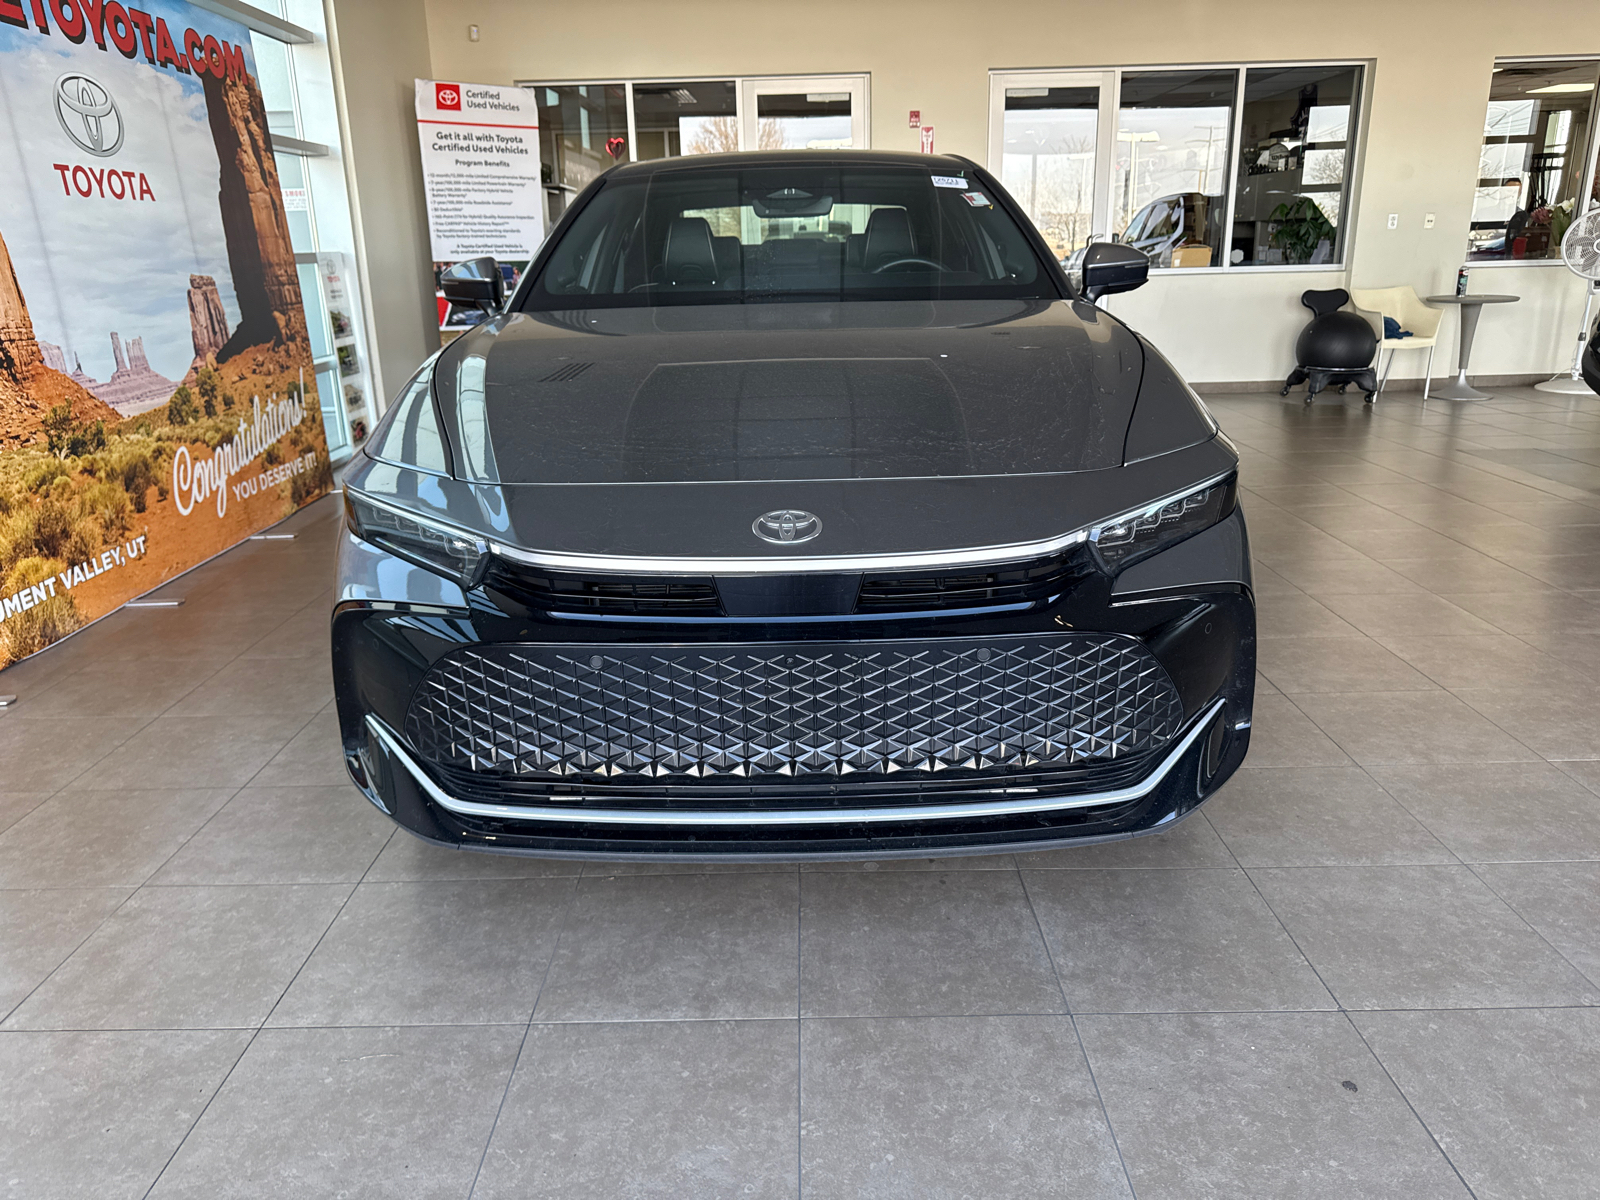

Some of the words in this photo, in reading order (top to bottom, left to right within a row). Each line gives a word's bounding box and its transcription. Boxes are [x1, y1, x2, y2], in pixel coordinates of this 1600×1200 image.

[466, 90, 500, 100] Certified
[467, 101, 487, 109] Used
[489, 102, 520, 112] Vehicles
[436, 131, 452, 141] Get
[454, 132, 461, 141] it
[463, 132, 474, 142] all
[475, 133, 495, 143] with
[495, 134, 523, 145] Toyota
[432, 143, 471, 152] Certified
[472, 144, 494, 153] Used
[494, 145, 529, 155] Vehicles
[455, 159, 483, 167] Program
[484, 159, 510, 168] Benefits
[53, 163, 156, 202] TOYOTA
[173, 367, 307, 518] Congratulations!
[232, 481, 258, 502] YOU
[258, 456, 305, 491] DESERVE
[303, 451, 318, 471] IT!
[59, 546, 126, 590] VALLEY,
[126, 535, 146, 559] UT
